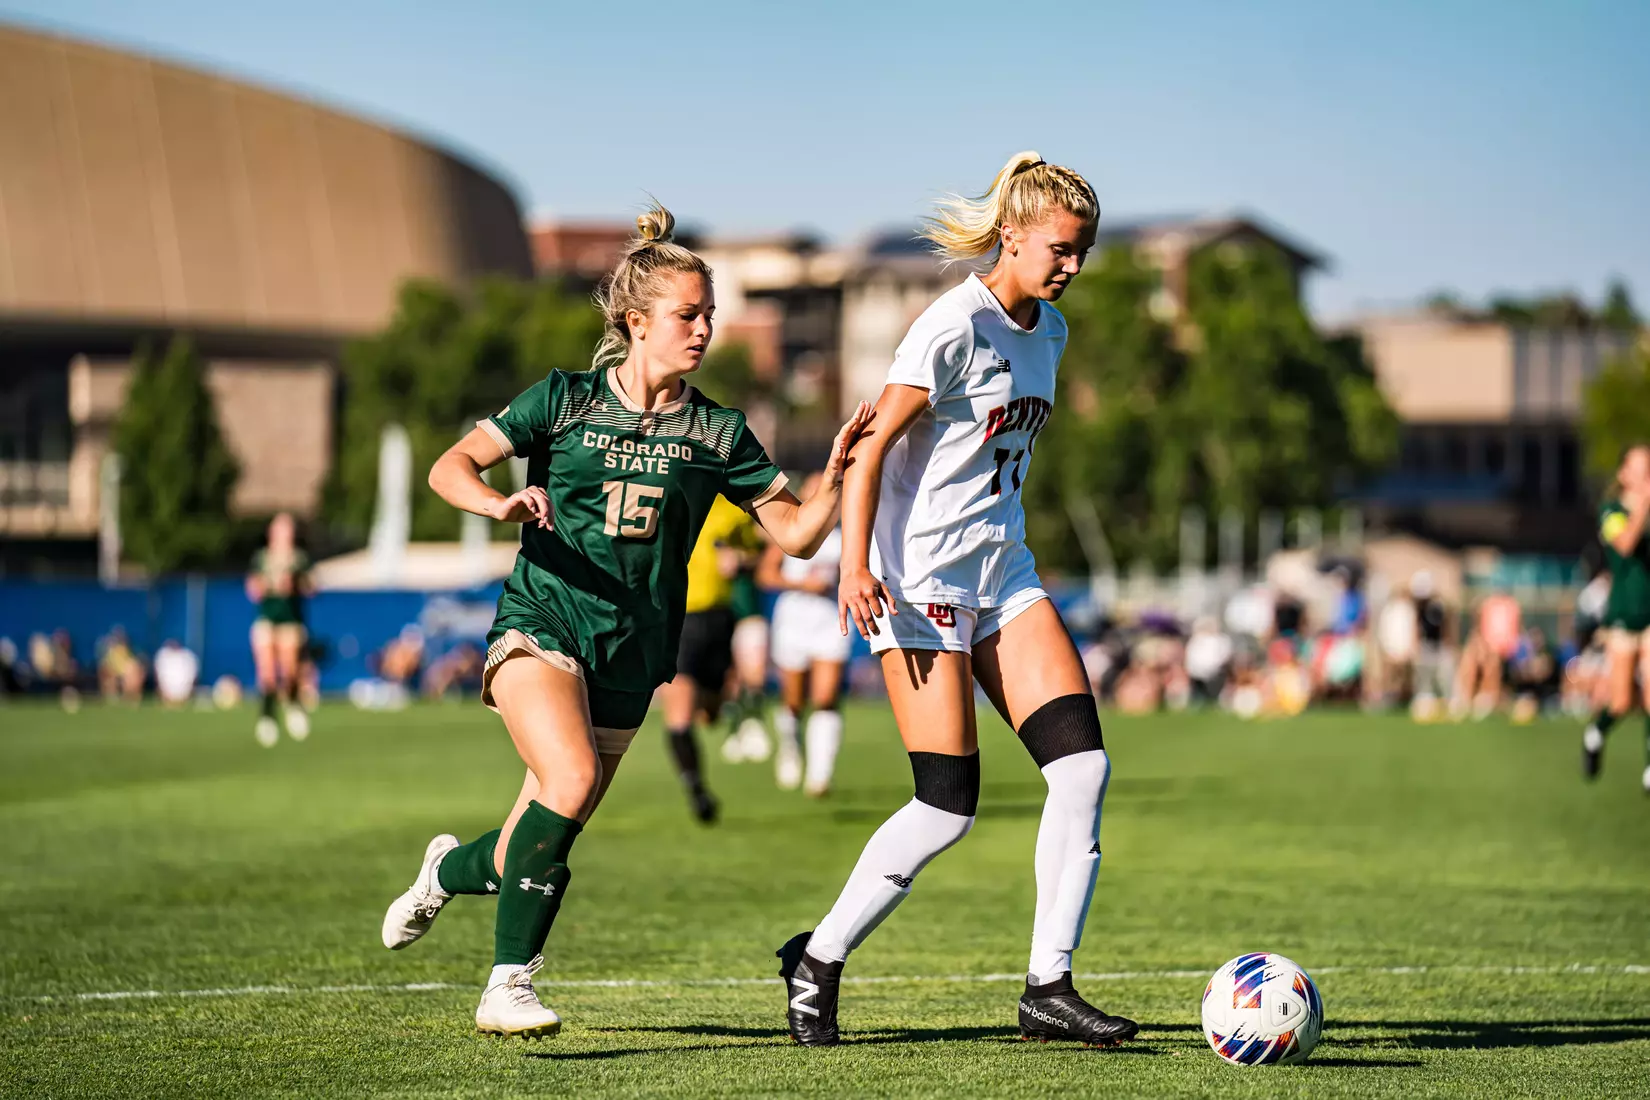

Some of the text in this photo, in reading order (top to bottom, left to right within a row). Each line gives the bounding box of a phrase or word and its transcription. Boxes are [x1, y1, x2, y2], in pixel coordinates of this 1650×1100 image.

[583, 431, 693, 461] COLORADO
[604, 452, 670, 474] STATE
[602, 481, 664, 538] 15
[790, 977, 819, 1017] N
[1031, 1006, 1069, 1030] balance
